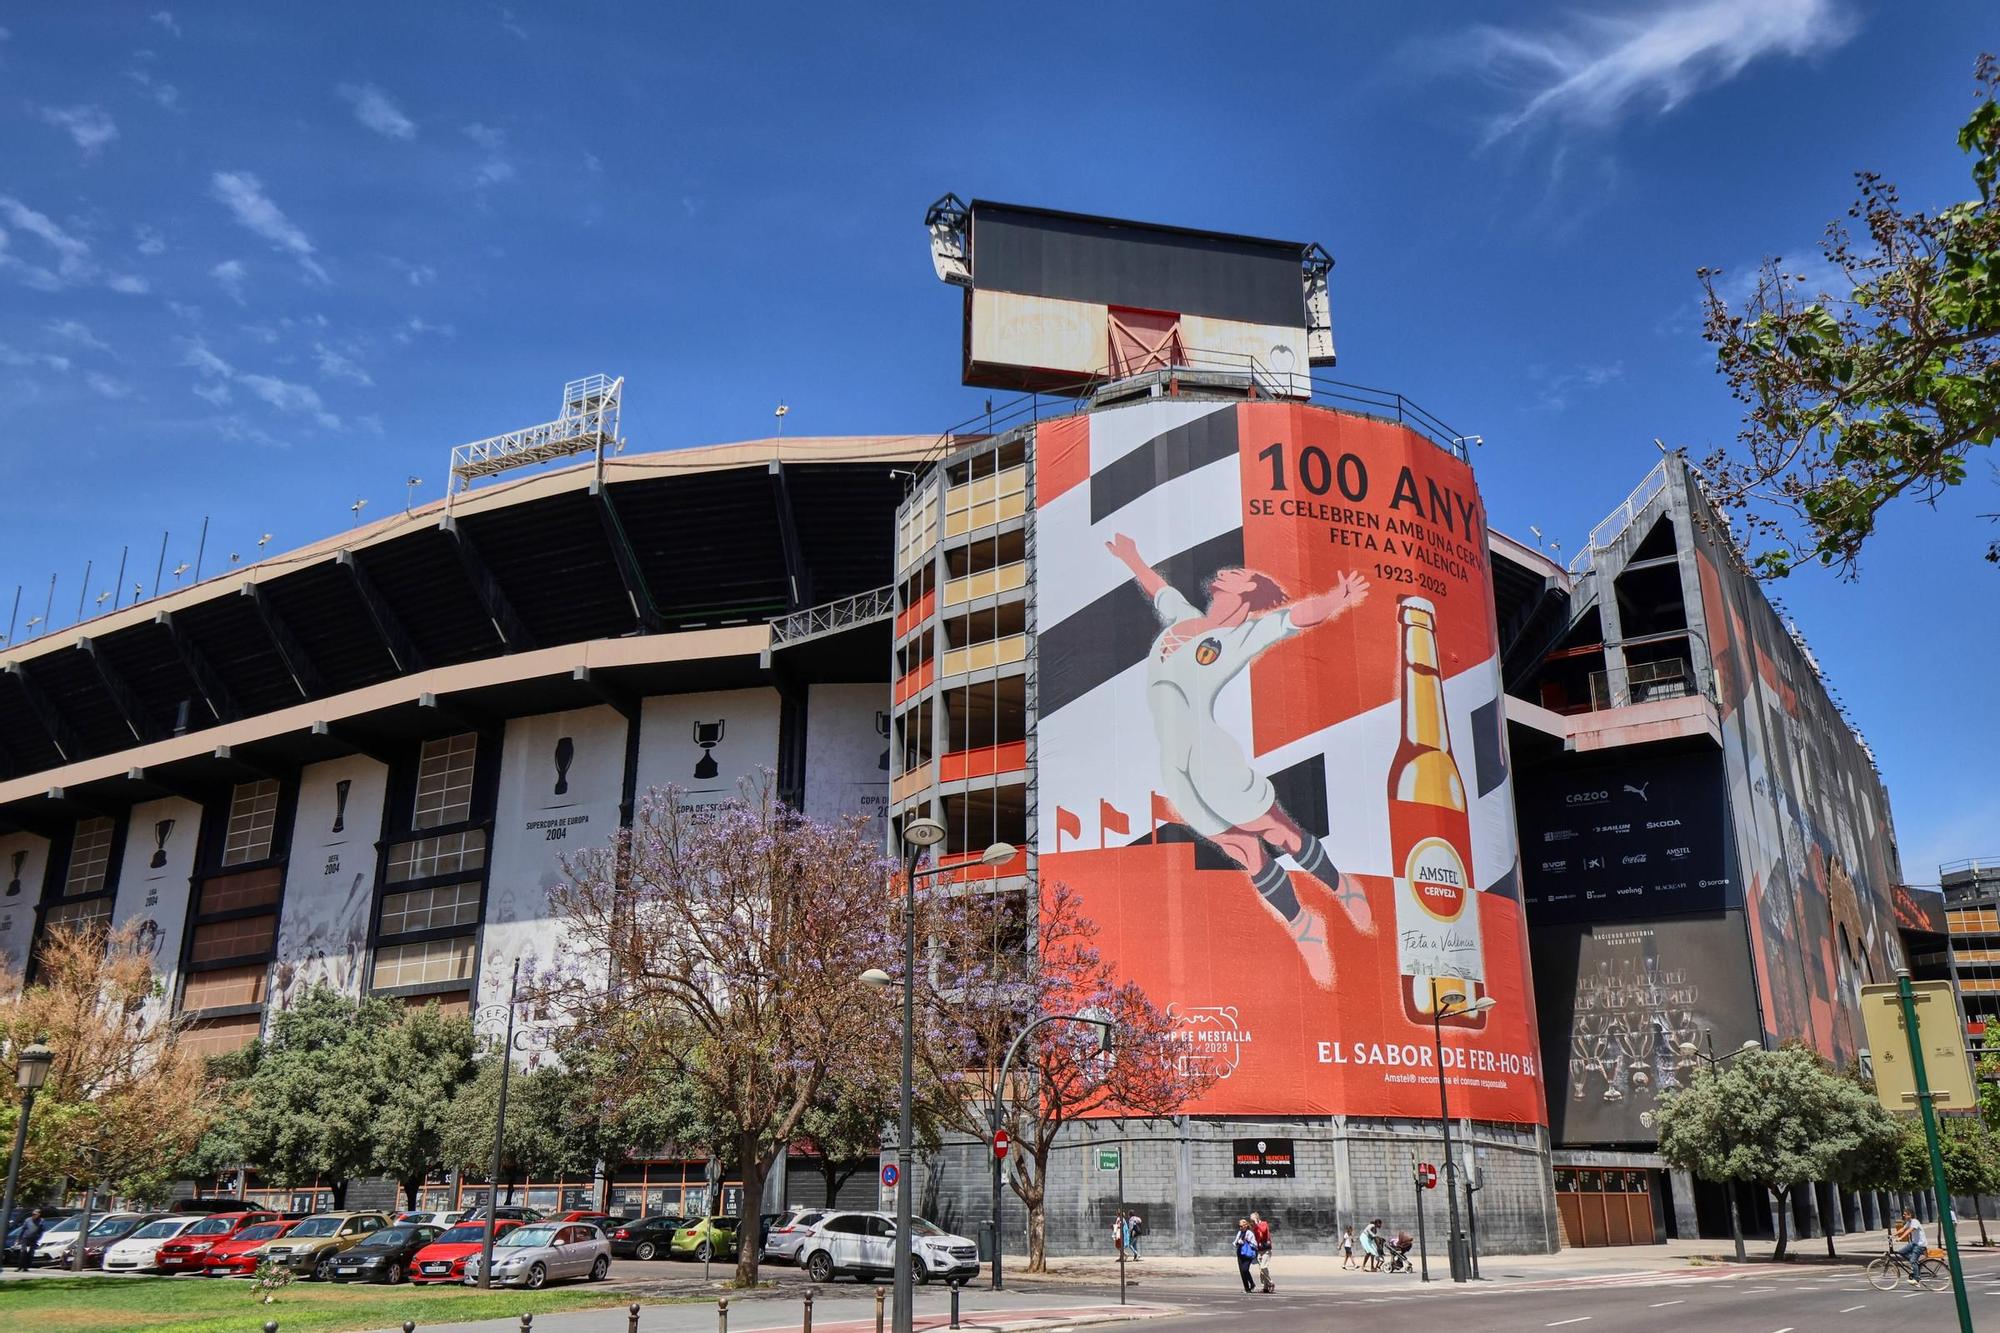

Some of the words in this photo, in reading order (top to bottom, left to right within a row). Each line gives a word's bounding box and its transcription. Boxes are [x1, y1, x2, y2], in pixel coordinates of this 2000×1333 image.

[1258, 443, 1368, 503] 100
[1249, 499, 1274, 516] SE
[1280, 499, 1380, 530] CELEBREN
[1386, 517, 1425, 541] AMB
[1427, 529, 1454, 556] UNA
[1330, 527, 1377, 551] FETA
[1383, 538, 1397, 554] A
[1401, 540, 1469, 583] VALÈNCIA
[1374, 563, 1447, 597] 1923-2023
[861, 796, 880, 804] COPA
[1566, 790, 1609, 803] CAZOO
[676, 804, 694, 814] COPA
[526, 819, 558, 830] SUPERCOPA
[559, 818, 566, 826] DE
[567, 815, 589, 825] EUROPA
[1646, 819, 1681, 829] ŠKODA
[546, 827, 567, 841] 2004
[1666, 847, 1691, 855] AMSTEL
[1419, 866, 1459, 885] AMSTEL
[1424, 886, 1457, 899] CERVEZA
[1617, 887, 1643, 895] vueling
[1401, 929, 1429, 952] Feta
[1430, 940, 1437, 949] a
[1198, 1030, 1252, 1042] MESTALLA
[1205, 1042, 1228, 1053] 2023
[1317, 1041, 1347, 1063] EL
[1354, 1042, 1433, 1067] SABOR
[1440, 1047, 1466, 1069] DE
[1469, 1049, 1520, 1075] FER-HO
[1453, 1075, 1459, 1085] el
